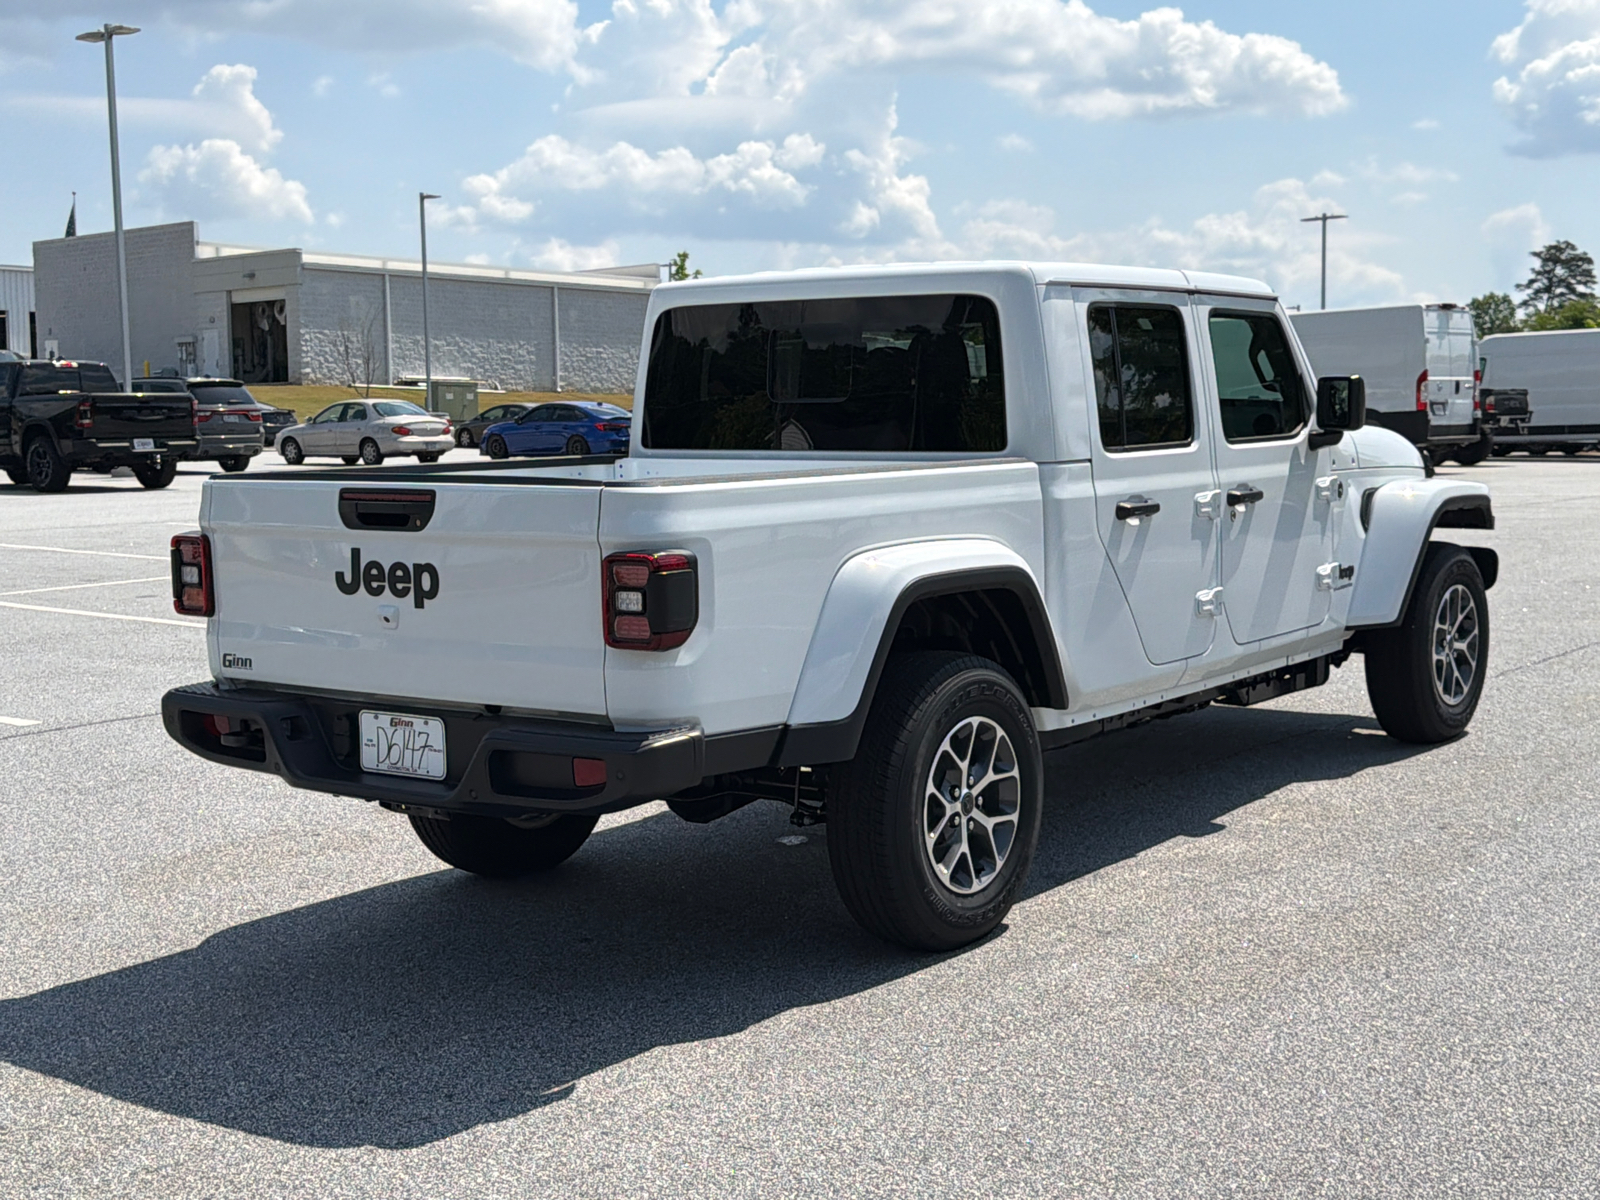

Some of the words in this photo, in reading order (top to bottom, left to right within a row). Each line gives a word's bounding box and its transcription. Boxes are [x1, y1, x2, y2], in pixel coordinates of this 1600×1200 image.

[335, 547, 440, 609] Jeep
[222, 652, 252, 669] Ginn
[389, 717, 414, 728] Ginn
